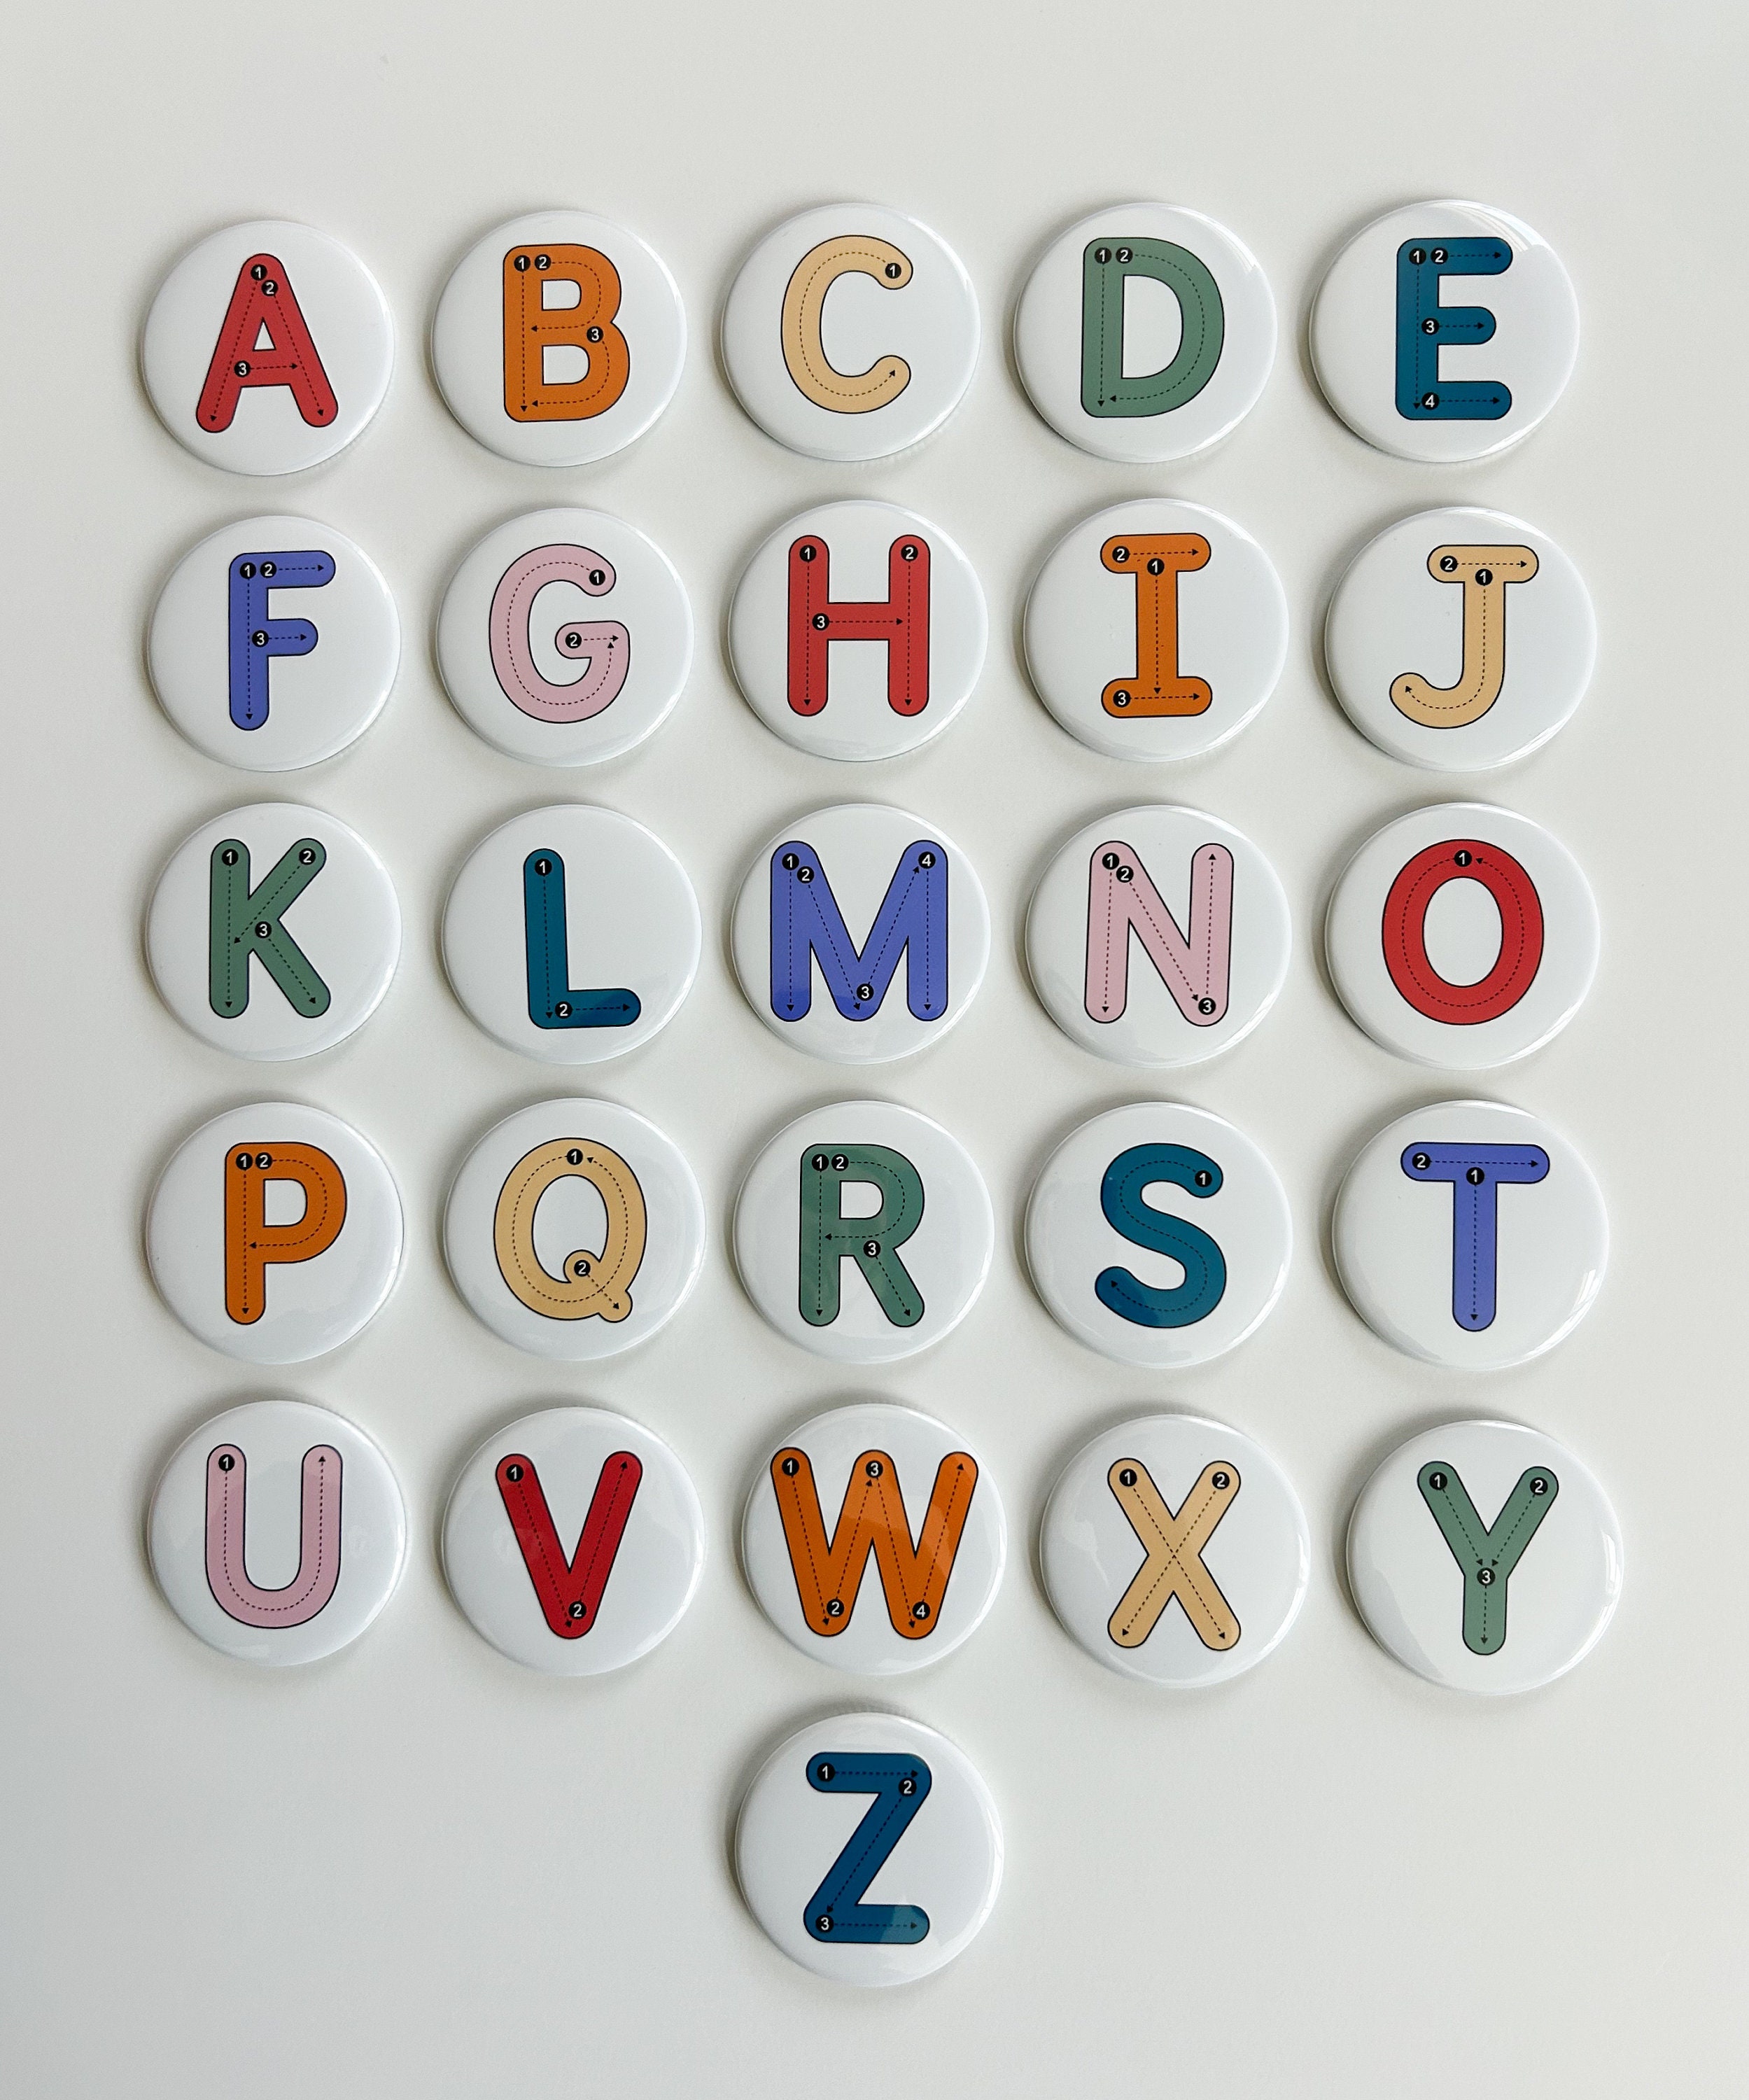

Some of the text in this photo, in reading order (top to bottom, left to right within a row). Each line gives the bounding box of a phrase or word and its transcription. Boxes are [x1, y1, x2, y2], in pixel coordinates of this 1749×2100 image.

[1099, 249, 1129, 262] 1 2
[1413, 249, 1444, 263] 1 2
[519, 256, 547, 270] 1 2
[255, 266, 261, 279] 1
[890, 265, 896, 277] 1
[266, 281, 274, 295] 2
[780, 234, 913, 414] C
[1081, 237, 1225, 418] D
[1395, 237, 1513, 420] E
[1426, 320, 1435, 333] 3
[503, 243, 630, 423] B
[591, 328, 600, 341] 3
[195, 253, 338, 433] A
[239, 362, 247, 376] 3
[1425, 394, 1435, 407] 4
[804, 547, 810, 560] 1
[905, 546, 914, 560] 2
[1116, 548, 1125, 561] 2
[1151, 560, 1158, 573] 1
[1445, 557, 1453, 570] 2
[244, 564, 273, 578] 1 2
[593, 571, 600, 584] 1
[1480, 570, 1487, 583] 1
[787, 535, 930, 717] H
[817, 615, 825, 629] 3
[1100, 533, 1212, 718] I
[228, 550, 336, 731] F
[256, 632, 265, 645] 3
[489, 544, 631, 724] G
[570, 634, 578, 647] 2
[1389, 545, 1539, 729] J
[1118, 692, 1127, 706] 3
[226, 851, 232, 864] 1
[303, 850, 312, 863] 2
[787, 855, 793, 868] 1
[921, 854, 932, 867] 4
[1107, 855, 1114, 868] 1
[1459, 852, 1466, 865] 1
[539, 860, 546, 874] 1
[1120, 867, 1130, 881] 2
[801, 868, 810, 881] 2
[209, 838, 331, 1018] K
[259, 923, 268, 937] 3
[770, 840, 948, 1022] M
[1085, 841, 1234, 1027] N
[1382, 839, 1544, 1026] O
[524, 848, 641, 1029] L
[861, 986, 870, 999] 3
[559, 1003, 568, 1016] 2
[1202, 1000, 1212, 1013] 3
[240, 1154, 269, 1168] 1 2
[570, 1151, 577, 1163] 1
[816, 1156, 845, 1169] 1 2
[1417, 1154, 1426, 1168] 2
[1199, 1172, 1206, 1185] 1
[1470, 1169, 1477, 1183] 1
[224, 1142, 347, 1325] P
[493, 1138, 647, 1323] Q
[799, 1144, 925, 1327] R
[1095, 1143, 1226, 1329] S
[1400, 1142, 1550, 1331] T
[868, 1242, 877, 1256] 3
[578, 1261, 586, 1275] 2
[223, 1456, 229, 1469] 1
[787, 1460, 793, 1474] 1
[870, 1462, 879, 1476] 3
[511, 1466, 517, 1480] 1
[1124, 1471, 1130, 1485] 1
[1216, 1474, 1225, 1488] 2
[1434, 1474, 1440, 1488] 1
[1534, 1479, 1543, 1493] 2
[205, 1444, 342, 1629] U
[770, 1447, 978, 1640] W
[496, 1451, 642, 1639] V
[1107, 1458, 1241, 1651] X
[1417, 1461, 1559, 1656] Y
[1482, 1569, 1491, 1584] 3
[573, 1604, 582, 1618] 2
[831, 1601, 840, 1615] 2
[916, 1604, 926, 1618] 4
[822, 1765, 828, 1779] 1
[904, 1781, 912, 1794] 2
[803, 1751, 932, 1945] Z
[821, 1917, 829, 1931] 3
